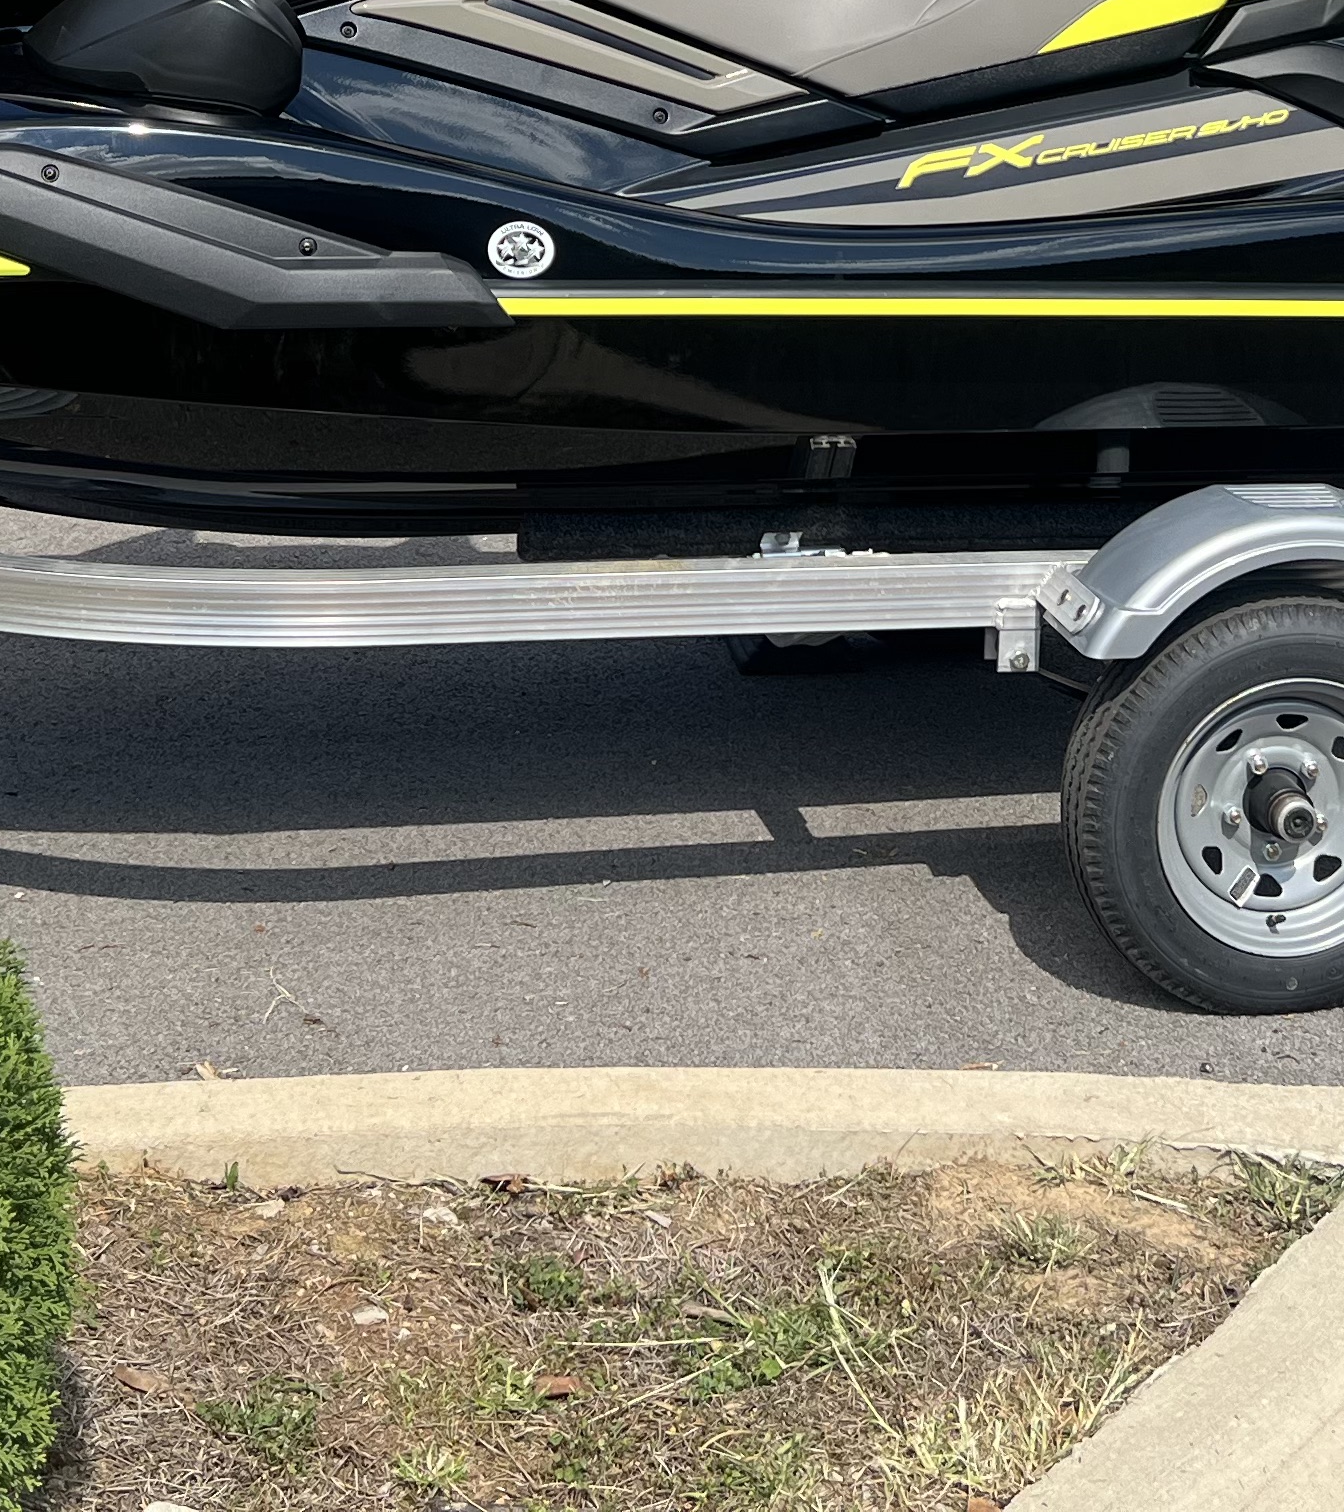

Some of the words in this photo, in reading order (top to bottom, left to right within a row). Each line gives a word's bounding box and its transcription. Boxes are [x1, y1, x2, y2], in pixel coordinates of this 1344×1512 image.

[895, 133, 1044, 190] FX
[1036, 124, 1196, 166] CRUISER
[1195, 108, 1290, 138] SVHO
